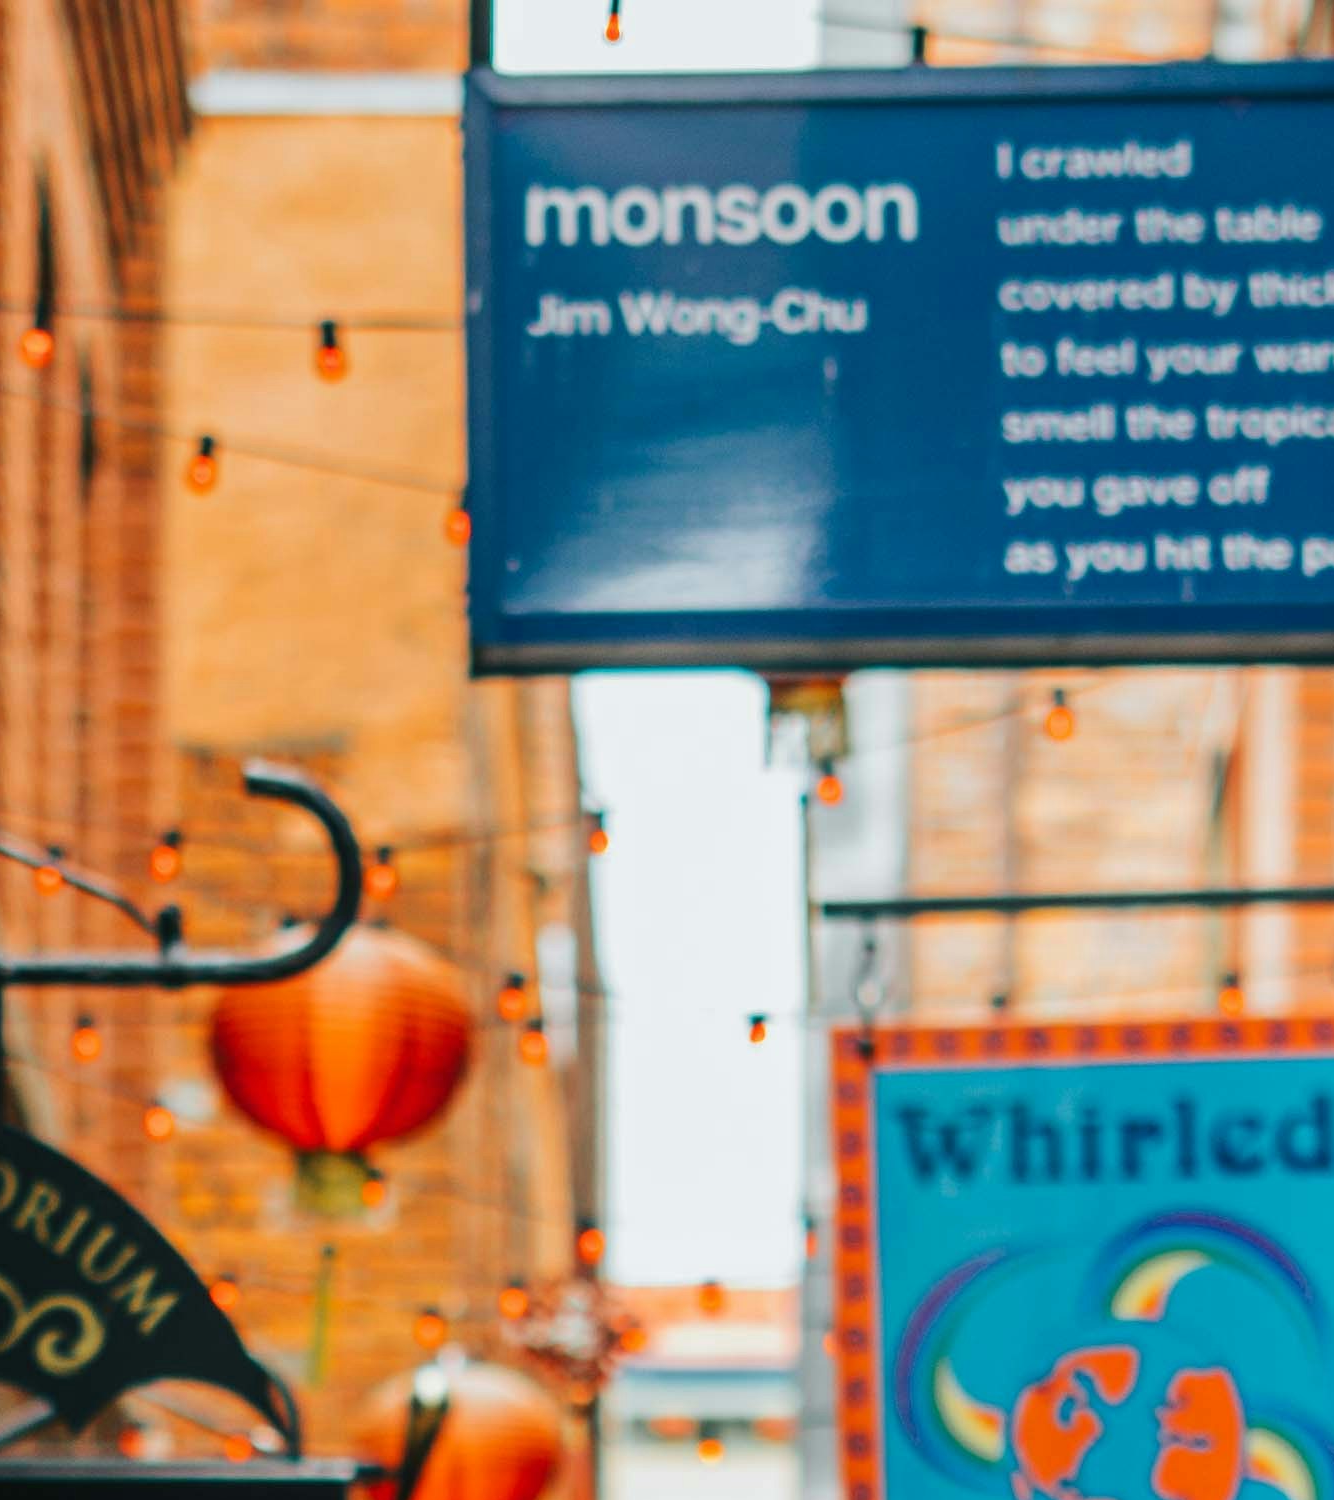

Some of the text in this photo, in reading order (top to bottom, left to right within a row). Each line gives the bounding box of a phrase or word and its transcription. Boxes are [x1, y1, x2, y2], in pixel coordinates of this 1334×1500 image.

[996, 139, 1192, 180] I crawled
[524, 182, 919, 247] monsoon
[997, 204, 1323, 246] under the table
[526, 286, 868, 347] Jim Wong-Chu
[998, 271, 1175, 312] covered
[1182, 270, 1239, 317] by
[1001, 340, 1047, 378] to
[1055, 335, 1137, 377] feel
[1145, 341, 1240, 383] your
[1001, 403, 1117, 444] smell
[1124, 403, 1196, 442] the
[1002, 464, 1271, 517] you gave off
[1004, 540, 1057, 575] as
[1064, 539, 1147, 582] you
[1154, 532, 1212, 572] hit
[1221, 531, 1294, 571] the
